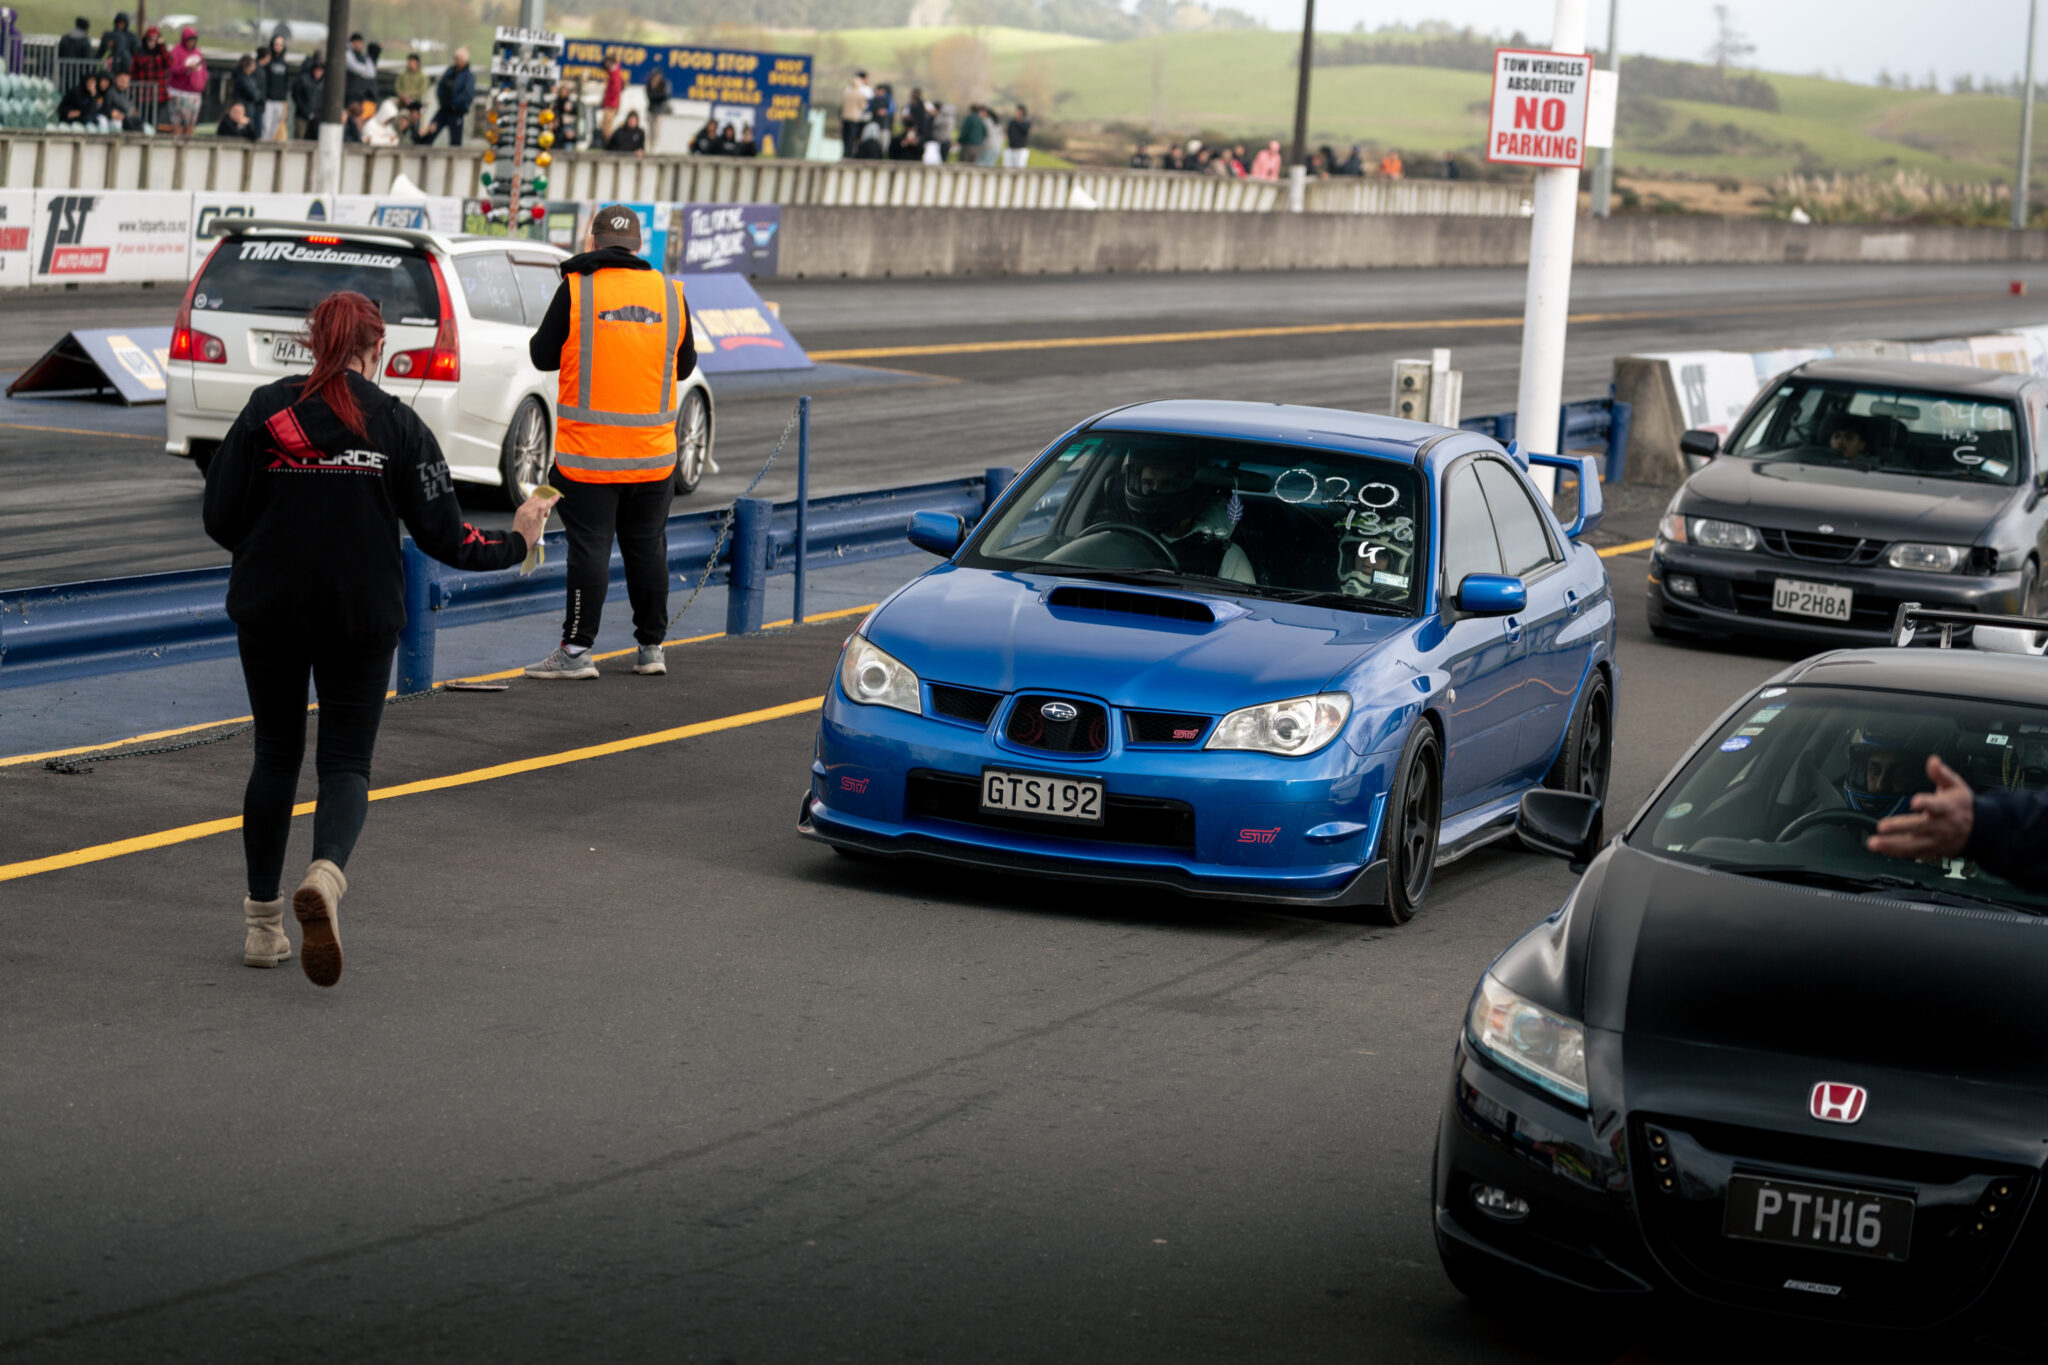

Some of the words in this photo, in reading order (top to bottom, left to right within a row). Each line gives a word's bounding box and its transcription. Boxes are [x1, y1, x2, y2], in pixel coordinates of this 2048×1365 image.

[567, 43, 603, 63] FUEL
[669, 49, 714, 70] FOOD
[716, 53, 759, 72] STOP
[501, 61, 556, 77] STAGE
[775, 59, 804, 72] HOT
[1503, 58, 1529, 73] TOW
[1531, 60, 1584, 76] VEHICLES
[695, 74, 744, 89] BACON
[768, 71, 808, 88] DOGS
[1507, 76, 1577, 94] ABSOLUTELY
[688, 86, 718, 101] EGG
[720, 89, 762, 105] ROLLS
[771, 95, 801, 107] HOT
[1513, 96, 1566, 132] NO
[1496, 132, 1578, 160] PARKING
[38, 196, 96, 274] 1ST
[57, 254, 79, 268] AUTO
[79, 252, 104, 268] PARTS
[1274, 468, 1400, 508] 020
[1776, 590, 1847, 617] UP2H8A
[987, 776, 1098, 815] GTS192
[1755, 1188, 1881, 1248] PTH16
